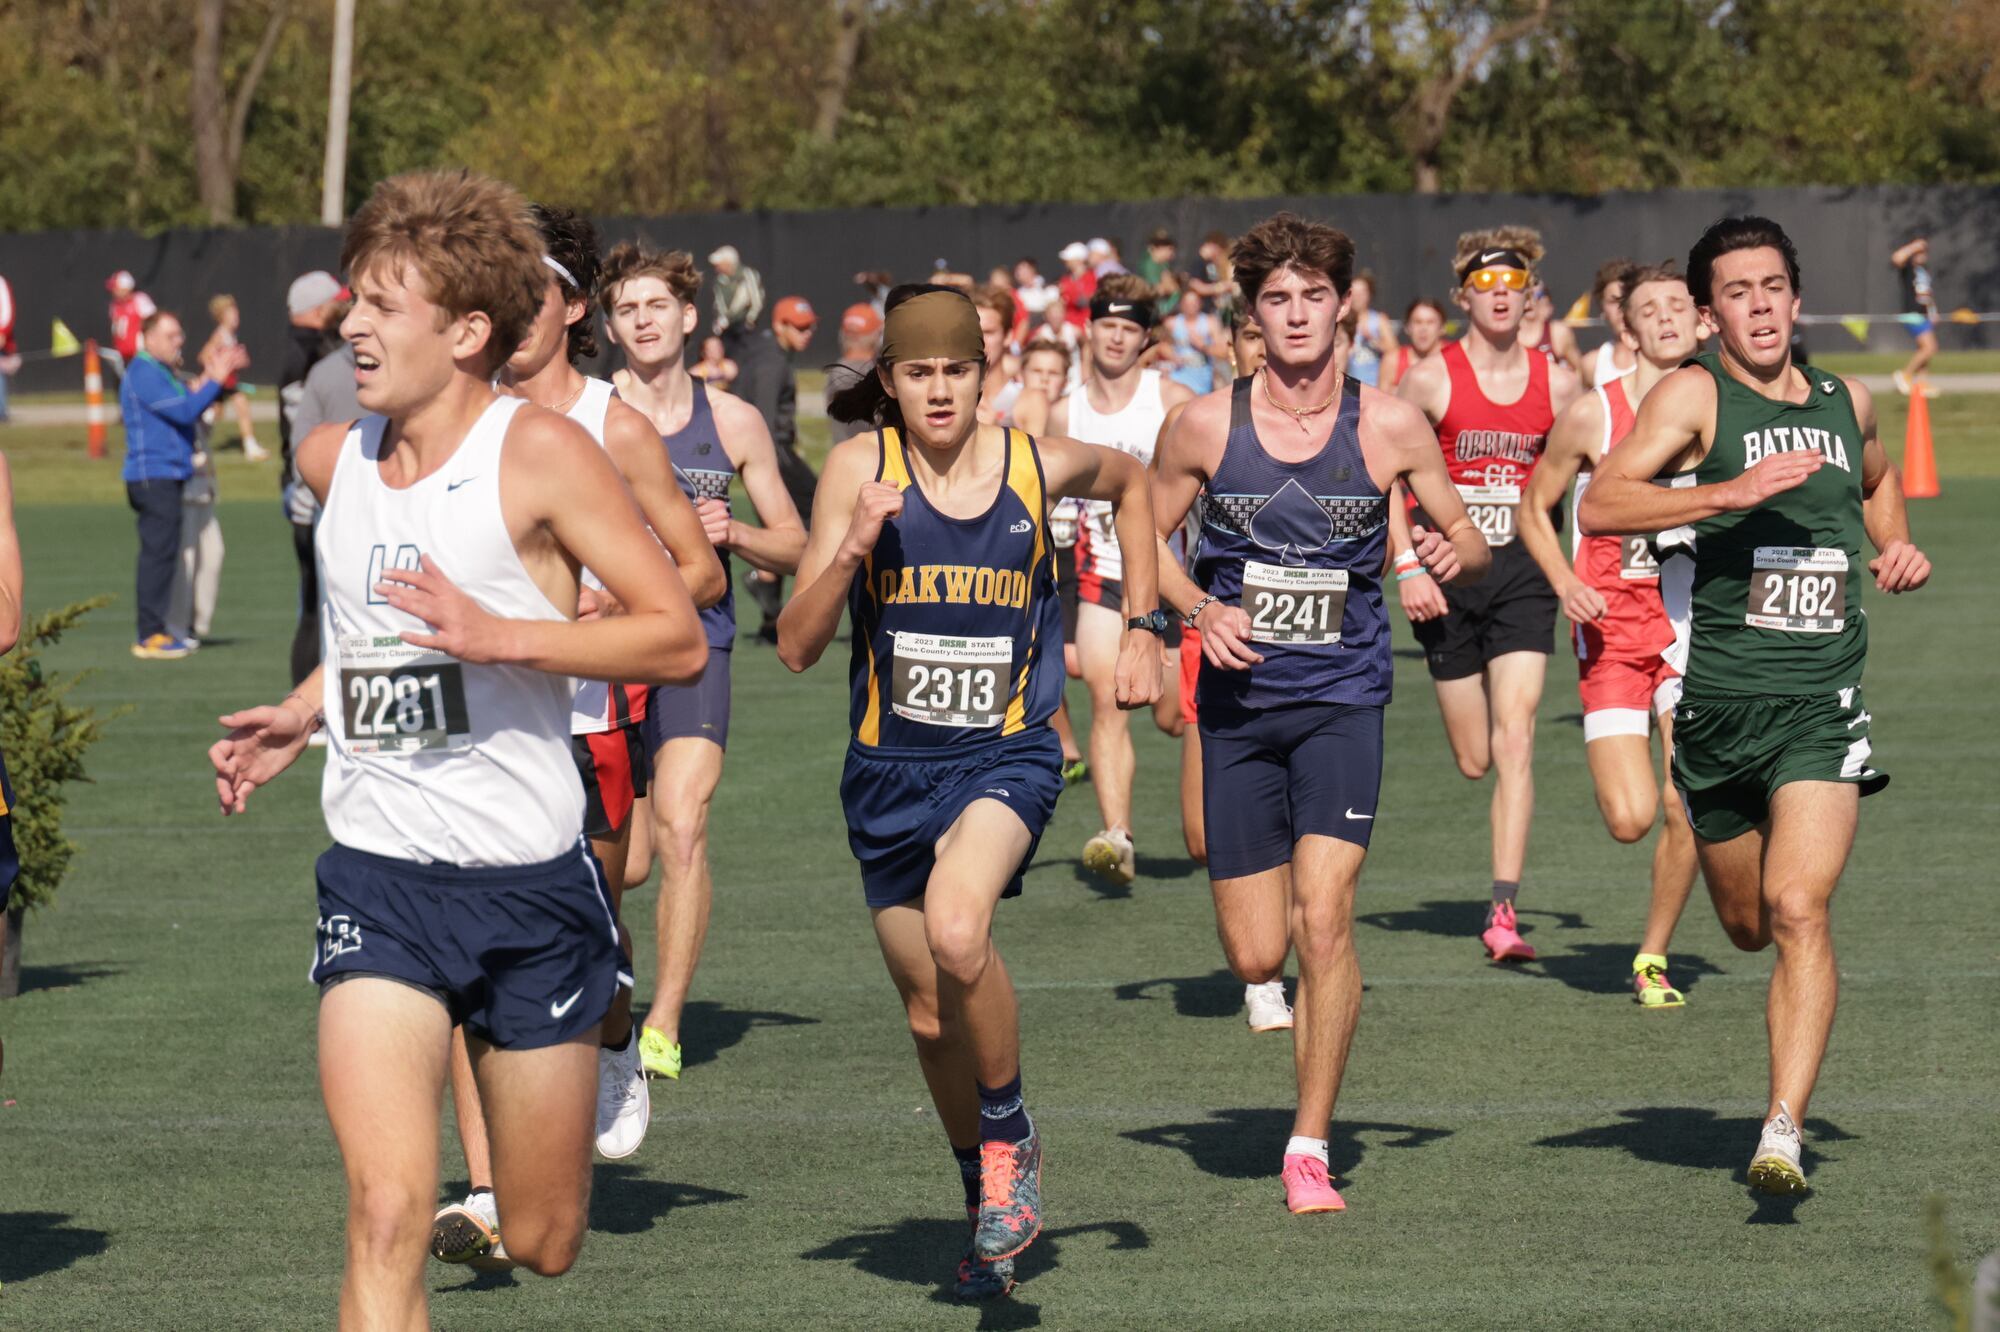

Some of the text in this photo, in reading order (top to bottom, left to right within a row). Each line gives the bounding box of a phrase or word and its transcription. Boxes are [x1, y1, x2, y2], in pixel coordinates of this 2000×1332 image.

[1743, 427, 1851, 472] BATAVIA
[880, 565, 1026, 608] OAKWOOD
[1246, 572, 1265, 581] Cross
[1267, 576, 1294, 585] Country
[1263, 568, 1279, 576] 2023
[1252, 591, 1330, 631] 2241
[1762, 574, 1837, 617] 2182
[896, 643, 1010, 657] Cross Country Championships
[914, 638, 934, 646] 2023
[350, 673, 446, 734] 2281
[907, 665, 996, 711] 2313
